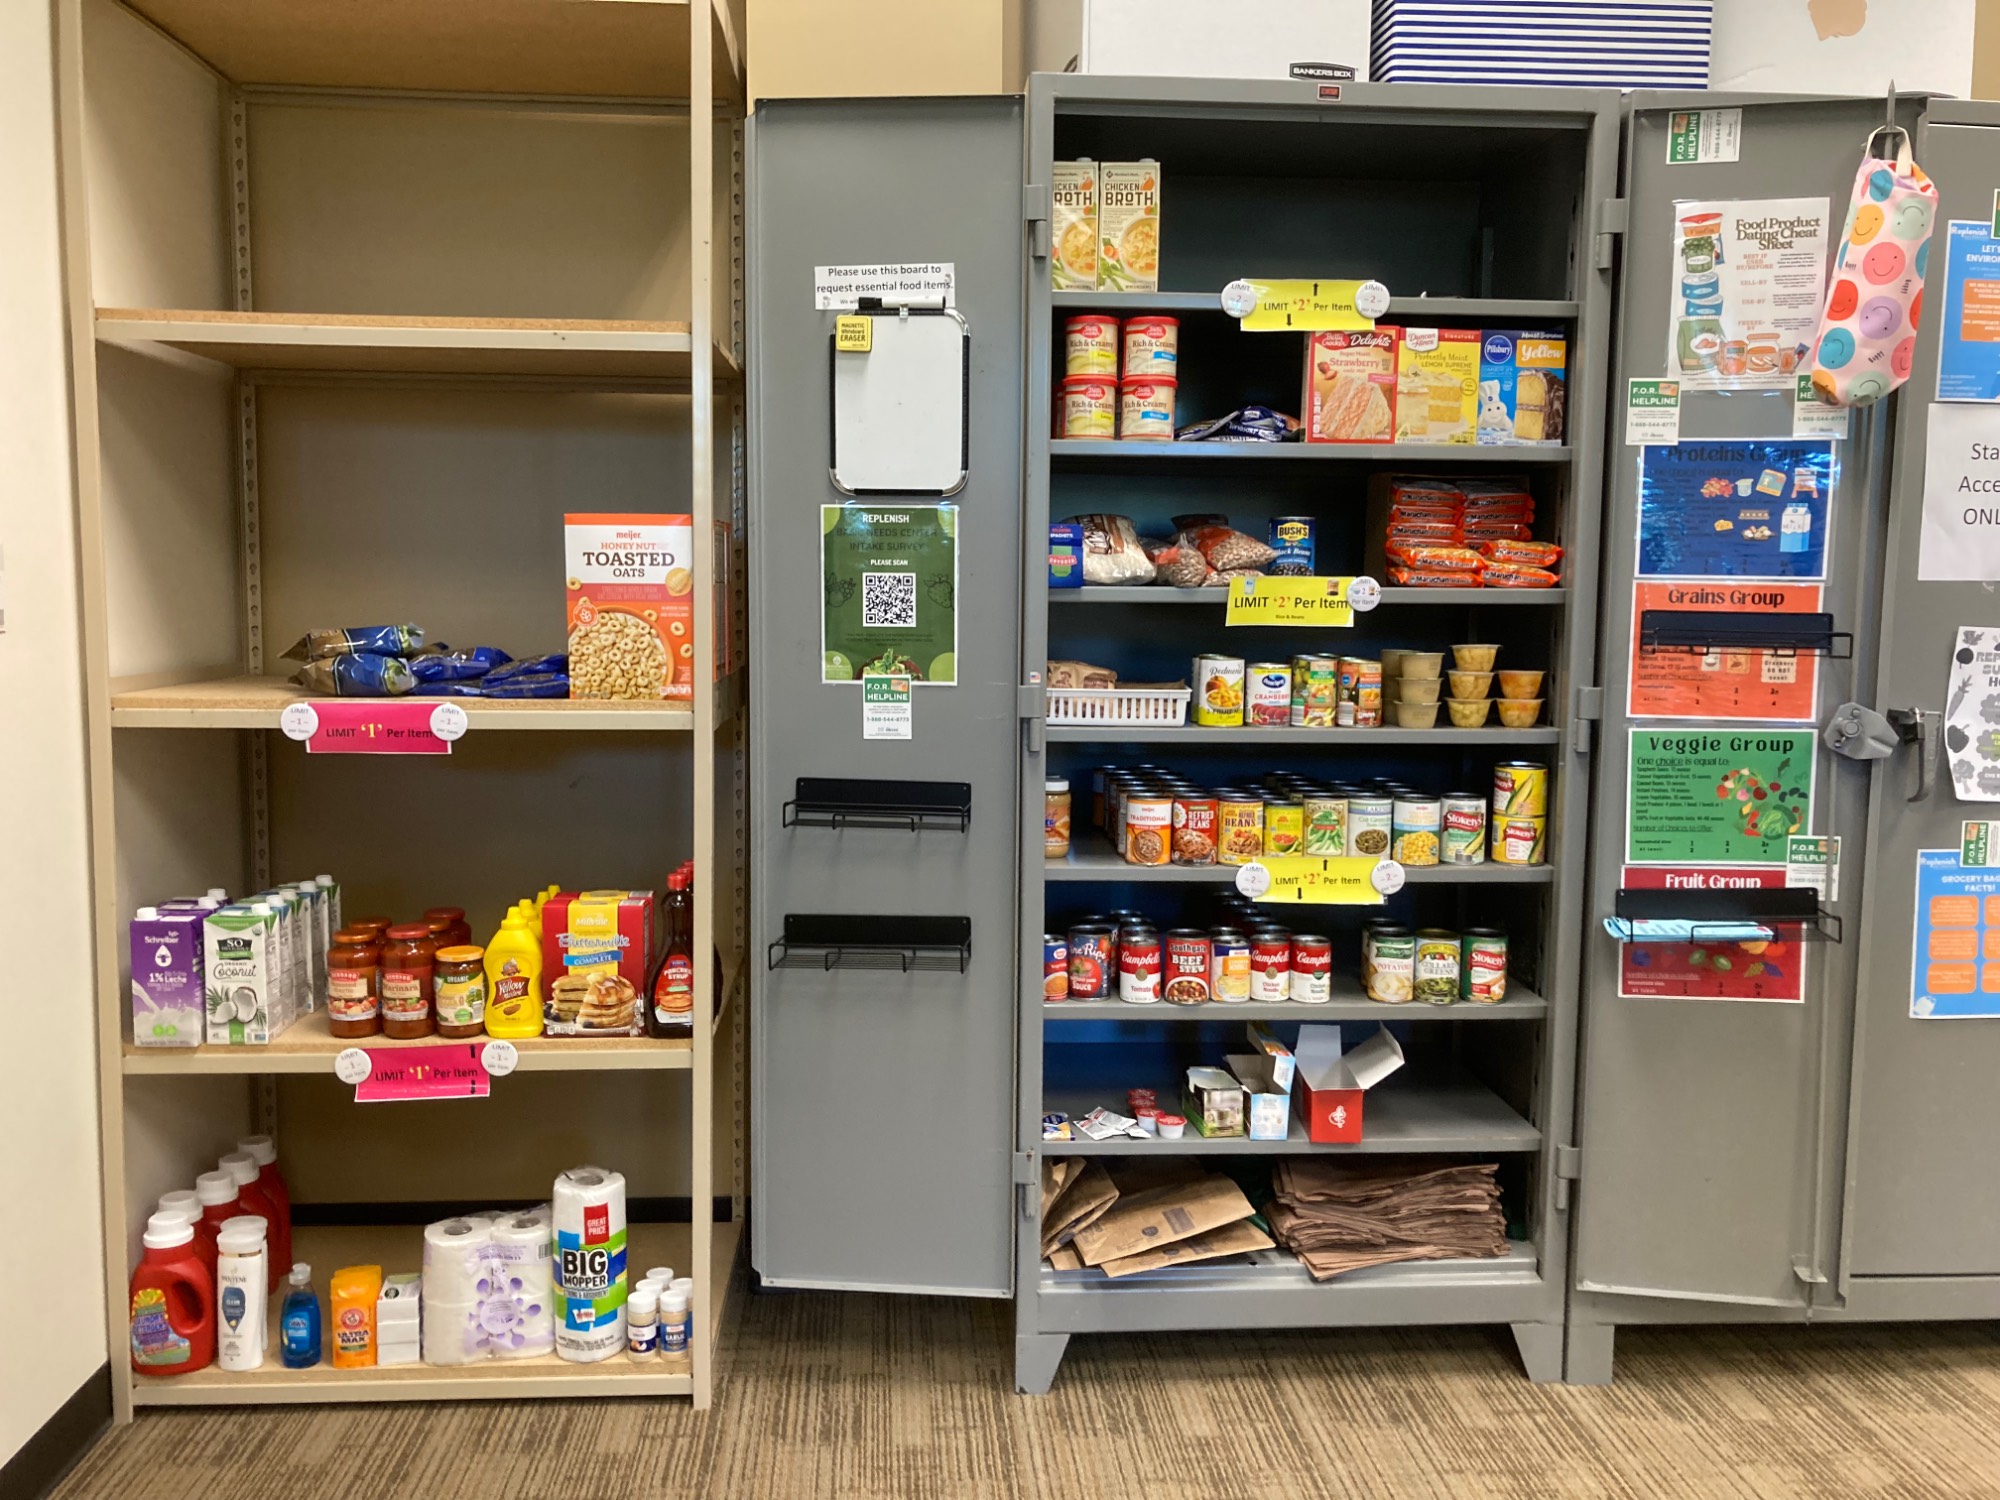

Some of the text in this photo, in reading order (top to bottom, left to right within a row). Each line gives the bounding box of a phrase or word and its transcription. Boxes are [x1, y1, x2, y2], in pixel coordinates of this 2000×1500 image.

[1293, 68, 1352, 78] BANKERS BOX
[1687, 114, 1699, 159] HELPLINE
[1676, 135, 1686, 159] F.O.R.
[1104, 183, 1140, 191] CHICKEN
[1105, 192, 1154, 206] BROTH
[1736, 216, 1822, 231] Food Product
[1736, 227, 1818, 242] Dating Cheat
[1951, 226, 1988, 238] Replenish
[1758, 239, 1794, 251] Sheet
[828, 265, 942, 277] Please use this board to
[817, 281, 954, 295] request essential food items.
[1264, 302, 1289, 311] LIMIT
[1314, 303, 1329, 312] Per
[1332, 302, 1352, 312] Item
[1350, 333, 1392, 348] Delights
[1408, 333, 1436, 342] Duncan
[1133, 340, 1147, 348] Rich
[1485, 345, 1512, 356] Pillsbury
[1521, 344, 1563, 361] Yellow
[1449, 353, 1468, 361] Moist
[1330, 358, 1380, 369] Strawberry
[1632, 387, 1658, 395] F.O.R.
[1143, 400, 1168, 409] Creamy
[1632, 397, 1677, 405] HELPLINE
[1667, 445, 1746, 462] Proteins
[862, 514, 910, 524] REPLENISH
[1400, 511, 1432, 519] Maruchan
[1470, 514, 1501, 522] Maruchan
[615, 531, 641, 540] meijer
[1279, 525, 1308, 537] BUSH'S
[1398, 527, 1429, 536] Maruchan
[1467, 528, 1498, 536] Maruchan
[600, 542, 656, 550] HONEY NUT
[849, 542, 884, 551] INTAKE
[582, 552, 675, 567] TOASTED
[613, 568, 645, 578] OATS
[1491, 571, 1522, 582] Maruchan
[1415, 575, 1449, 584] Maruchan
[1234, 596, 1270, 609] LIMIT
[1294, 597, 1316, 609] Per
[1319, 598, 1348, 609] Item
[1668, 588, 1785, 608] Grains Group
[867, 693, 908, 701] HELPLINE
[326, 728, 356, 738] LIMIT
[387, 728, 404, 738] Per
[408, 728, 433, 738] Item
[1649, 736, 1794, 754] Veggie Group
[1637, 757, 1717, 767] One choice is equal
[1188, 810, 1214, 820] REFRIED
[1446, 812, 1483, 827] Stokely's
[1189, 819, 1211, 829] BEANS
[1224, 817, 1256, 827] BEANS
[1505, 826, 1536, 838] Stokely's
[1978, 823, 1987, 864] HELPLINE
[1275, 877, 1299, 885] LIMIT
[1324, 877, 1338, 885] Per
[1341, 877, 1361, 885] Item
[1665, 873, 1706, 888] Fruit
[1941, 875, 1982, 884] GROCERY
[576, 917, 609, 926] Millville
[144, 936, 179, 944] Schreiber
[227, 939, 244, 947] SO
[555, 933, 631, 948] Buttermilk
[1083, 942, 1107, 961] Ripe
[1169, 943, 1207, 953] Southgate
[574, 955, 612, 966] COMPLETE
[1172, 955, 1203, 965] BEEF
[1471, 952, 1506, 967] Stokely's
[1179, 964, 1206, 973] STEW
[1422, 961, 1456, 969] COLLARD
[213, 963, 257, 980] Coconut
[1423, 967, 1454, 975] GREENS
[149, 972, 164, 983] 1%
[447, 975, 469, 983] ORGANIC
[383, 983, 419, 991] Marinara
[500, 980, 525, 993] Yellow
[1072, 982, 1092, 991] Sauce
[375, 1070, 405, 1081] LIMIT
[433, 1068, 451, 1078] Per
[454, 1068, 478, 1078] Item
[587, 1216, 607, 1227] GREAT
[588, 1225, 607, 1236] PRICE
[563, 1250, 607, 1276] BIG
[221, 1275, 247, 1284] PANTENE
[564, 1275, 606, 1288] MOPPER
[337, 1329, 369, 1339] ULTRA
[340, 1336, 366, 1344] MAX
